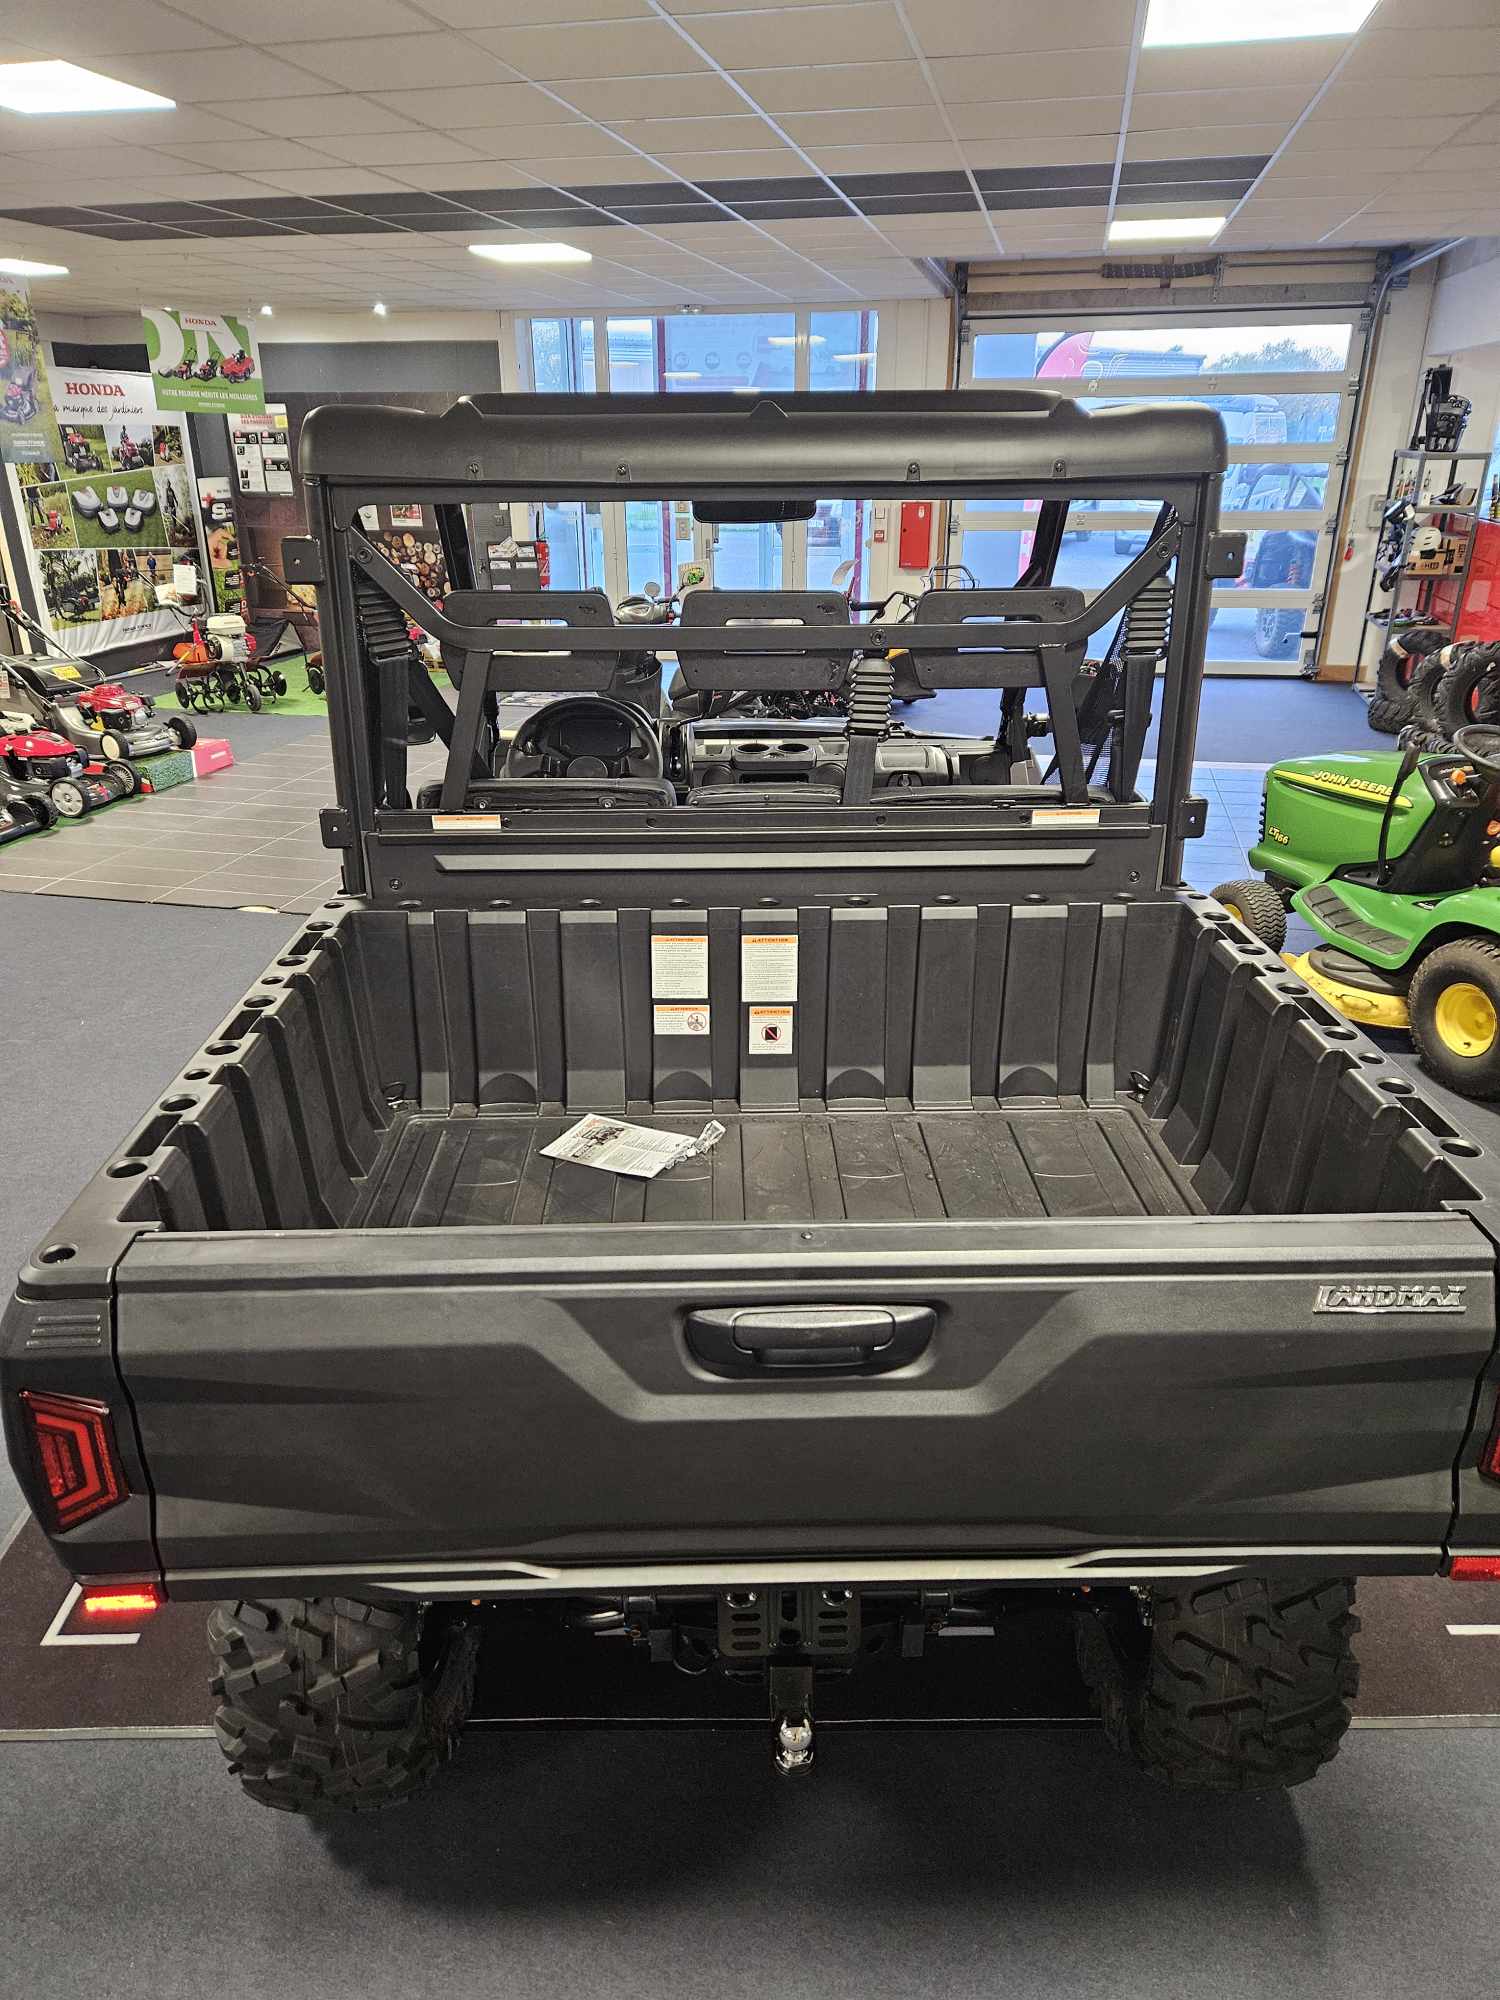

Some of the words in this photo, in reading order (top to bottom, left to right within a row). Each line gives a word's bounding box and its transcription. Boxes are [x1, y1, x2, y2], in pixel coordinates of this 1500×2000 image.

[185, 318, 217, 326] HONDA
[65, 382, 126, 397] HONDA
[63, 403, 93, 418] marque
[97, 401, 108, 413] des
[108, 402, 144, 422] jardiniers
[1313, 770, 1349, 786] JOHN
[1268, 826, 1289, 845] LT166
[1312, 1285, 1467, 1313] LANDMAX
